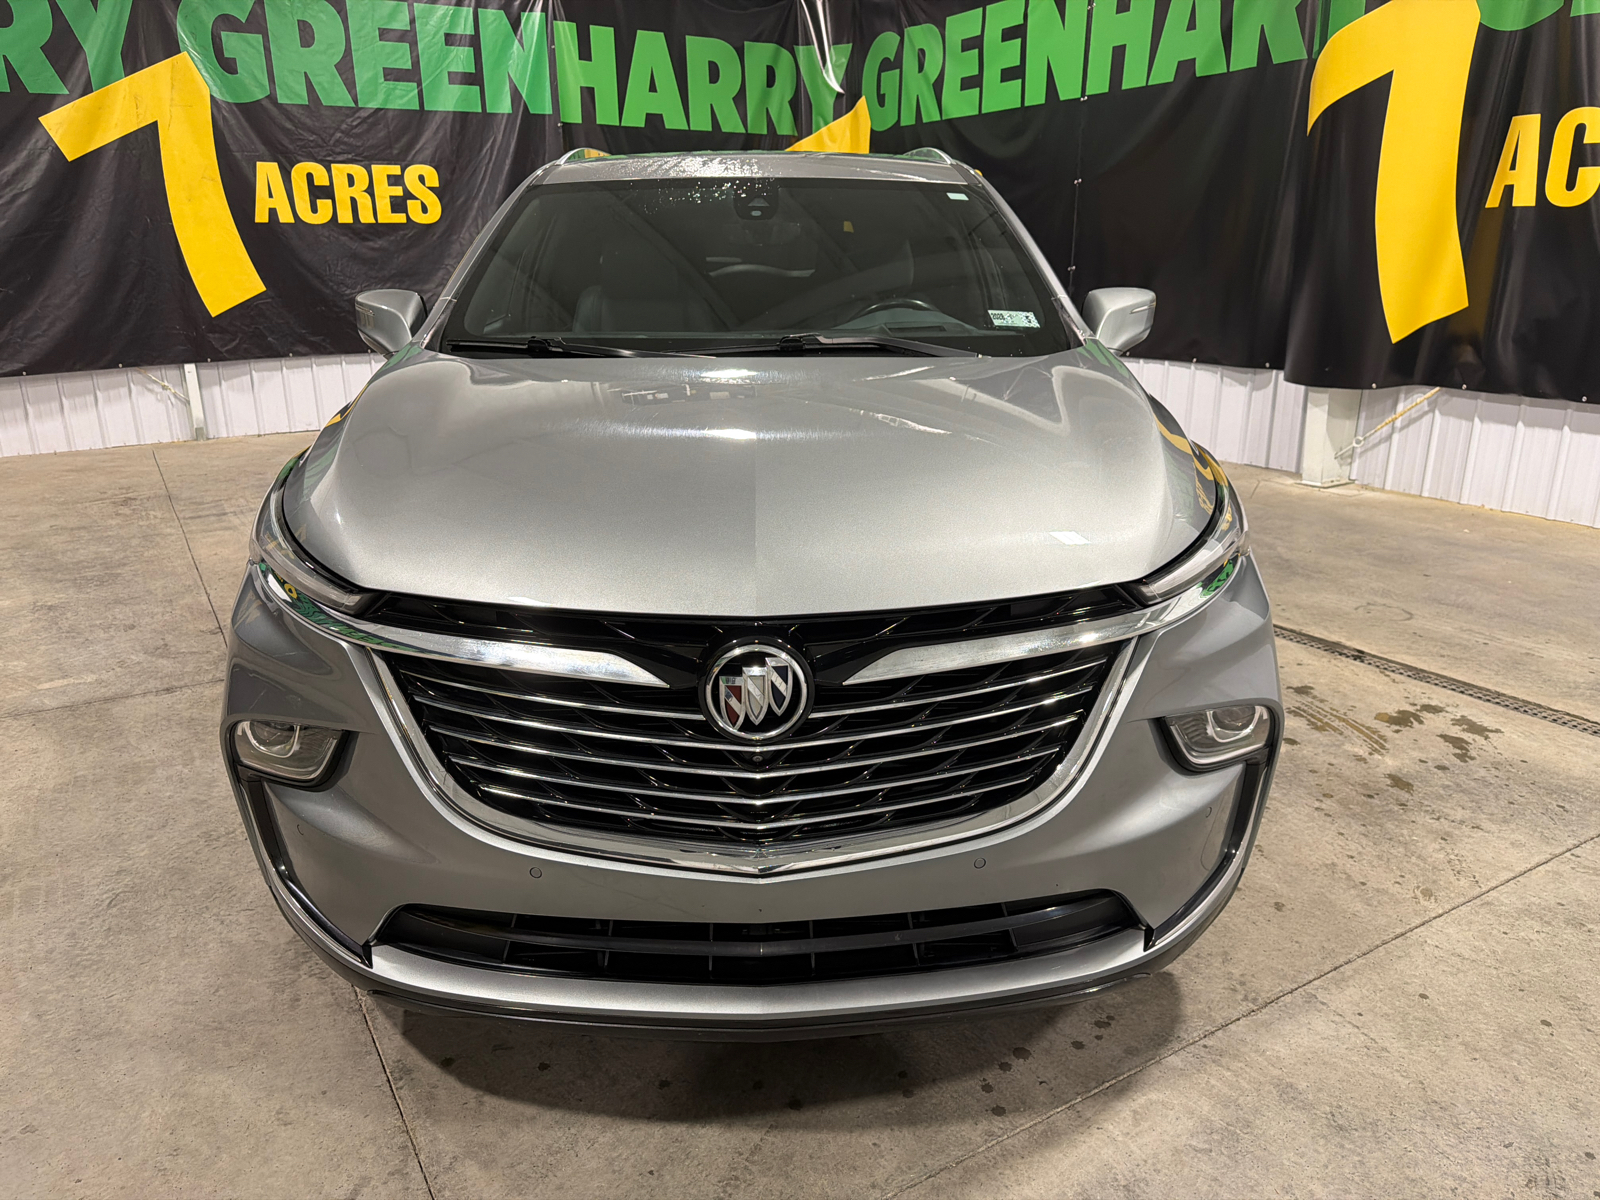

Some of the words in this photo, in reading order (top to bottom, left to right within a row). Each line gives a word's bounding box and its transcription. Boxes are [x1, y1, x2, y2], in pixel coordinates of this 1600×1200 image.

[177, 0, 553, 114] GREEN
[553, 20, 852, 136] HARRY
[862, 0, 1091, 131] GREEN
[38, 51, 267, 318] 7
[254, 161, 442, 224] ACRES
[1307, 0, 1480, 344] 7
